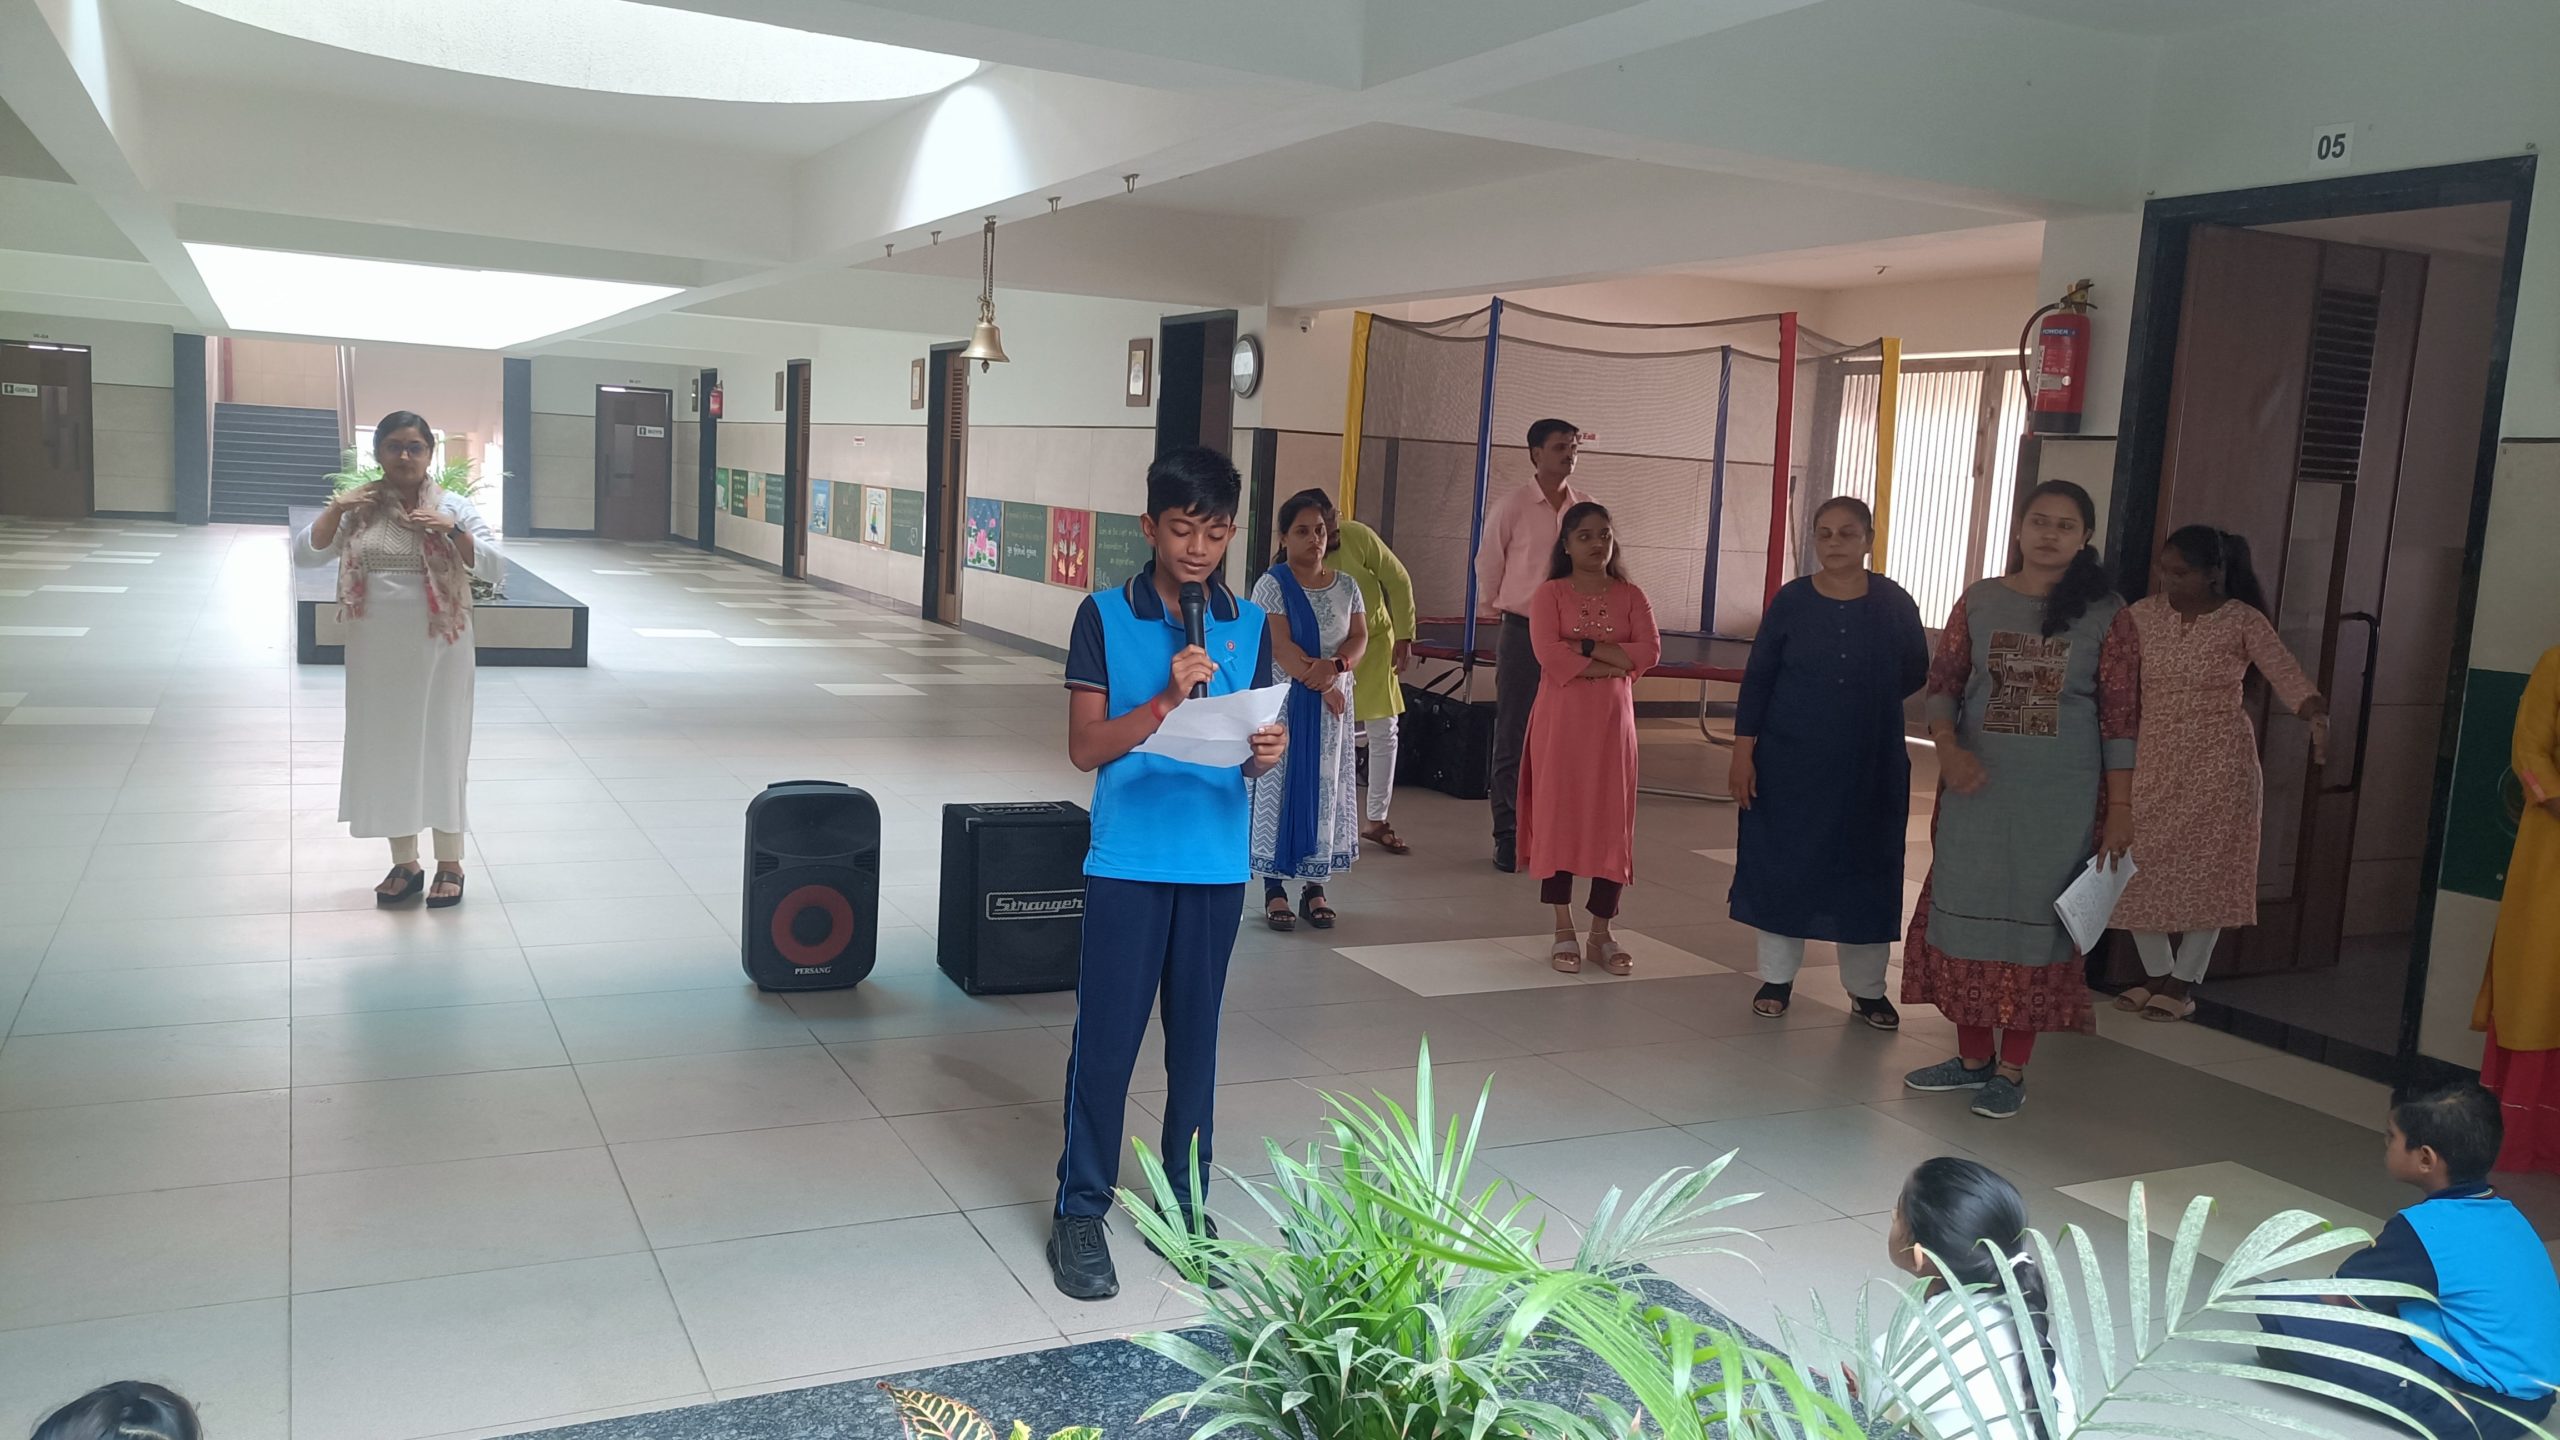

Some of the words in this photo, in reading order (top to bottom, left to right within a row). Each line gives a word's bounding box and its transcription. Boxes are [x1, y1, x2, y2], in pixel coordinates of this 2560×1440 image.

[2317, 133, 2346, 160] 05
[992, 897, 1084, 915] Stranger
[794, 966, 832, 975] PERSANG
